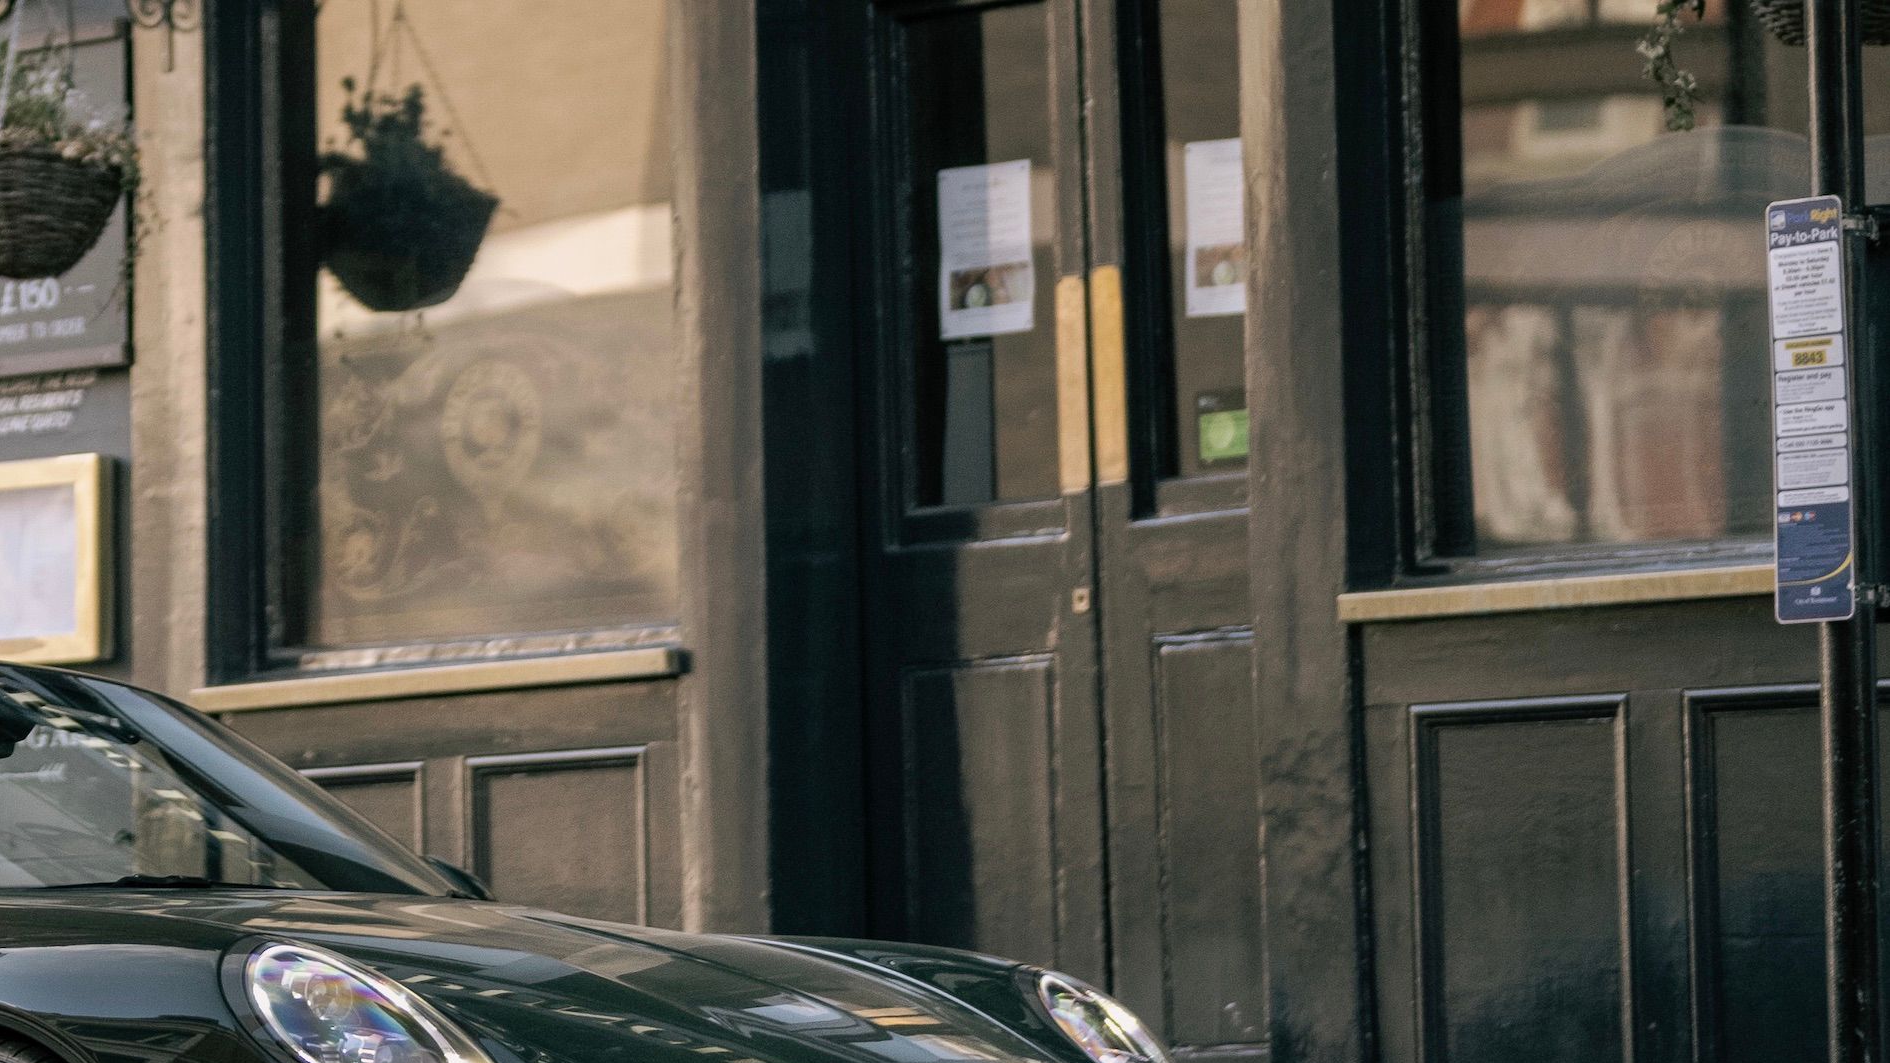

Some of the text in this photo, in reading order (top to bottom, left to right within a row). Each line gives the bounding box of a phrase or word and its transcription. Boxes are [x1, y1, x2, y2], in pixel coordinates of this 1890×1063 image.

[1810, 207, 1838, 224] Right
[1770, 226, 1838, 247] Pay-to-Park
[1794, 351, 1823, 366] 8843
